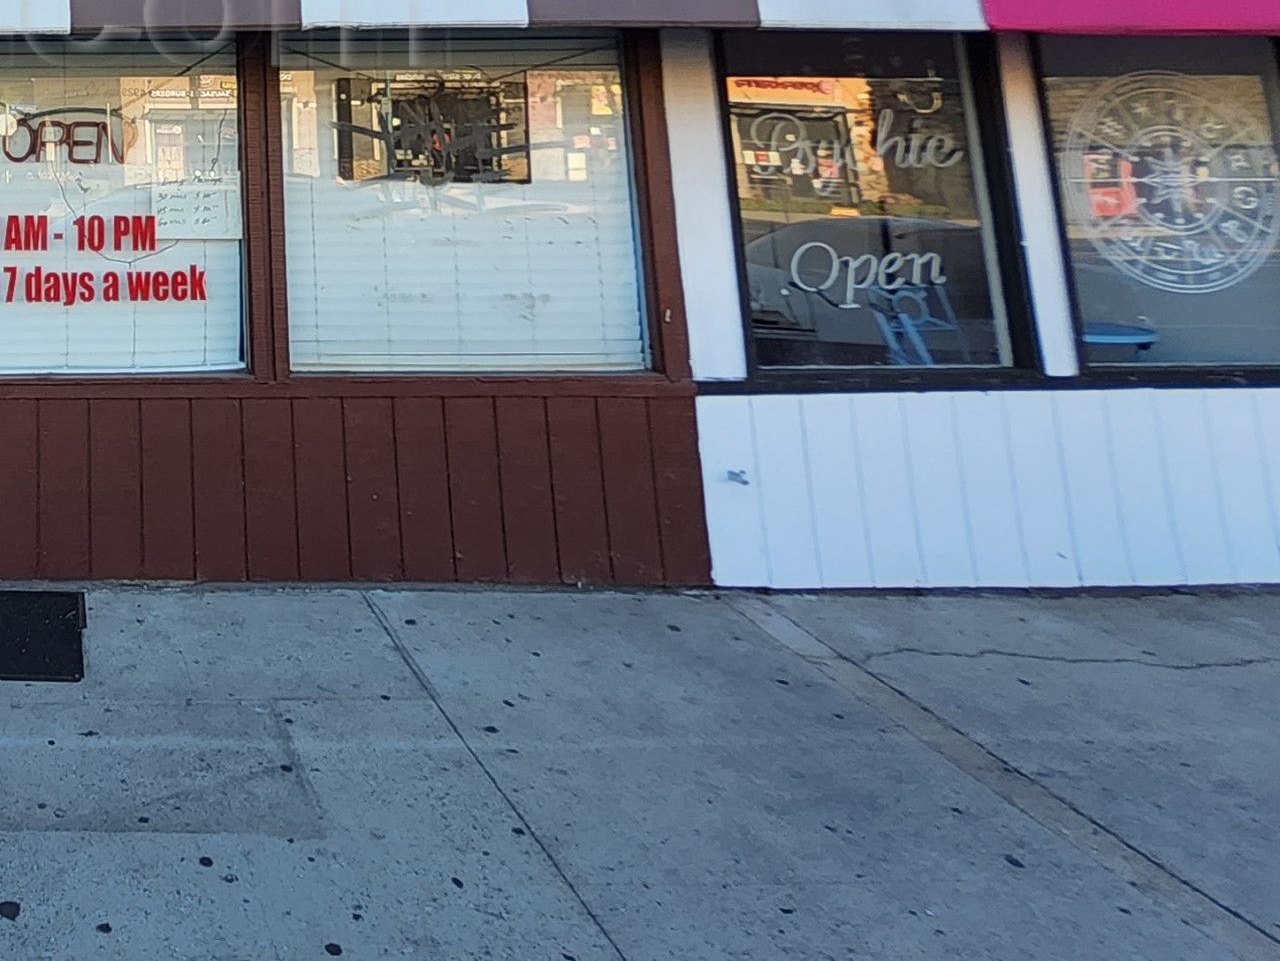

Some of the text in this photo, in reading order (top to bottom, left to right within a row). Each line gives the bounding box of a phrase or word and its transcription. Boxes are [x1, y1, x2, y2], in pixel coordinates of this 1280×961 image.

[2, 118, 127, 165] OPEN
[750, 108, 964, 197] Psyhic
[4, 215, 48, 251] AM
[73, 215, 105, 251] 10
[113, 215, 156, 251] PM
[4, 267, 17, 303] 7
[25, 266, 94, 306] days
[103, 270, 119, 301] a
[127, 264, 206, 301] week
[790, 242, 947, 309] Open
